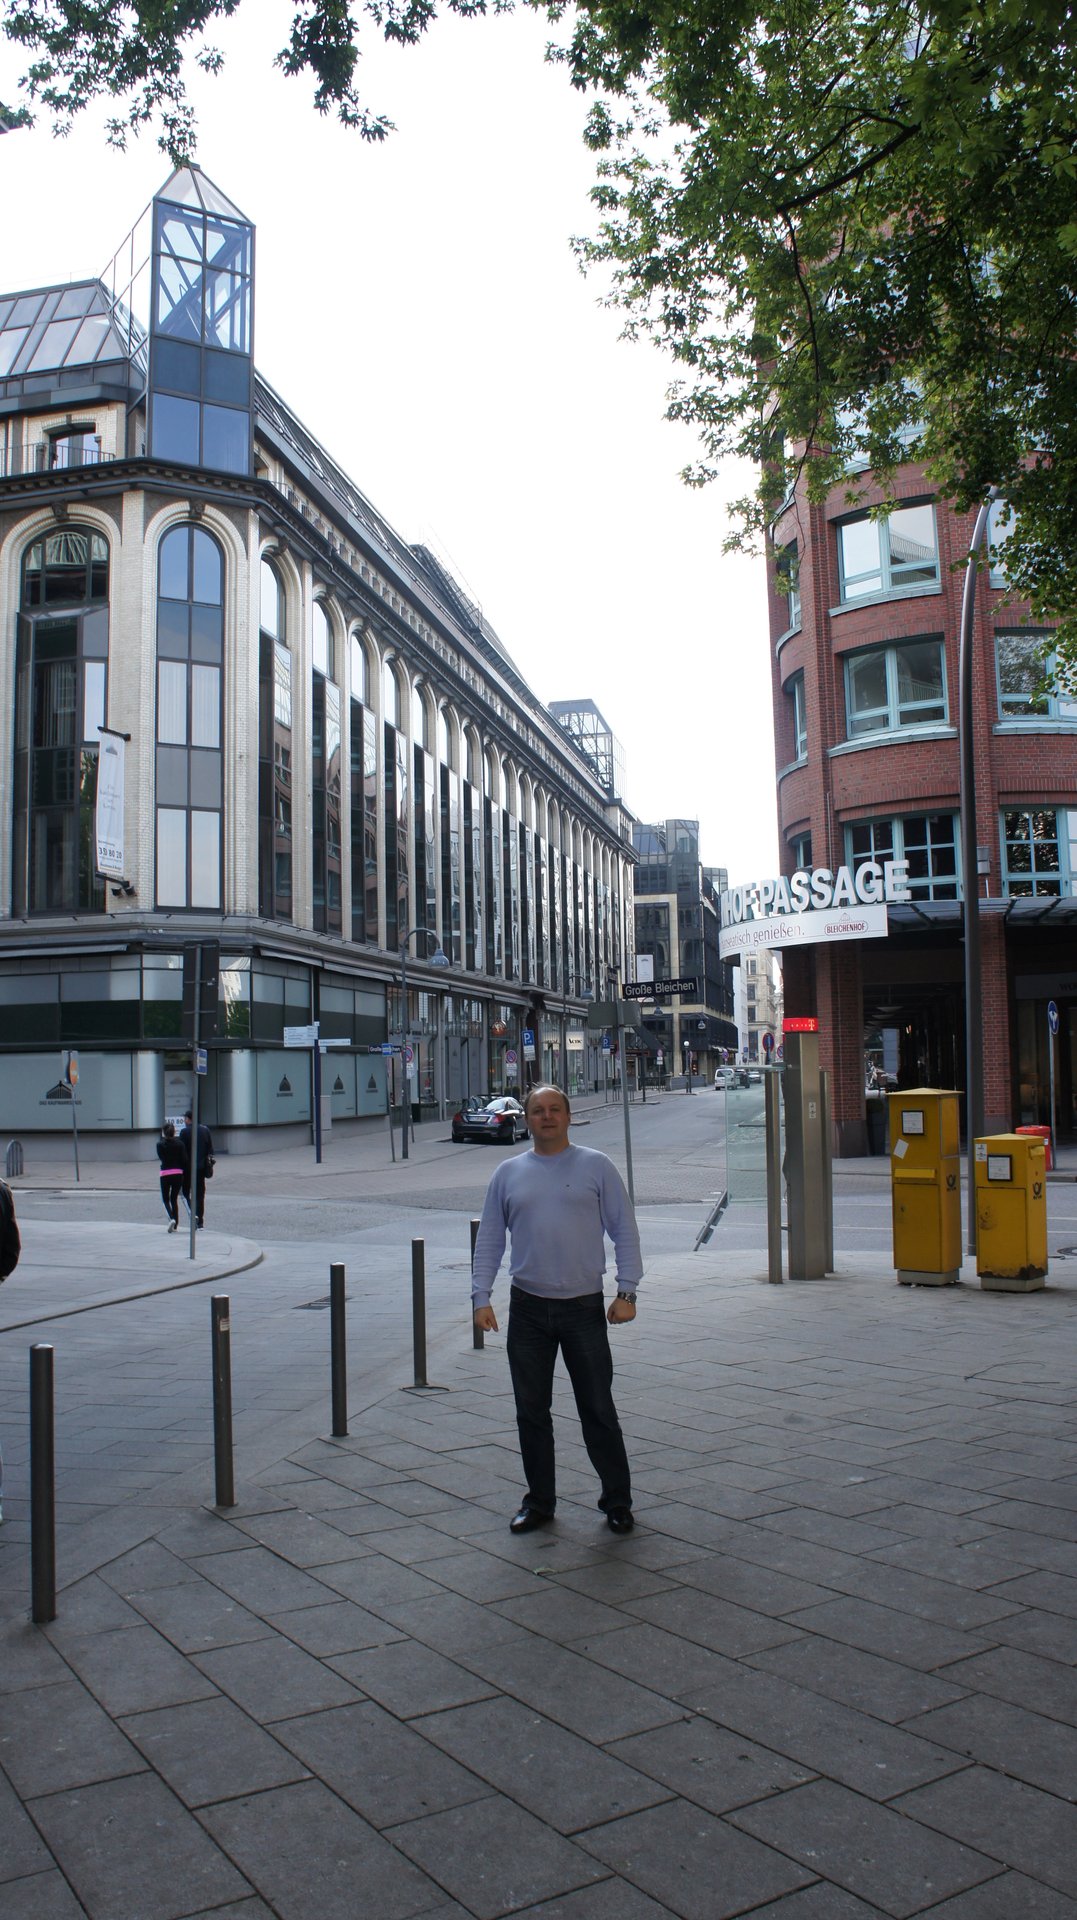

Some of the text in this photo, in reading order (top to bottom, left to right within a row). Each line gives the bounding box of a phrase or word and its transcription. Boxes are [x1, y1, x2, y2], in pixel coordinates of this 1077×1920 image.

[760, 859, 912, 916] PASSAGE
[826, 922, 865, 934] BLEICHENHOF
[625, 981, 695, 996] Große Bleichen
